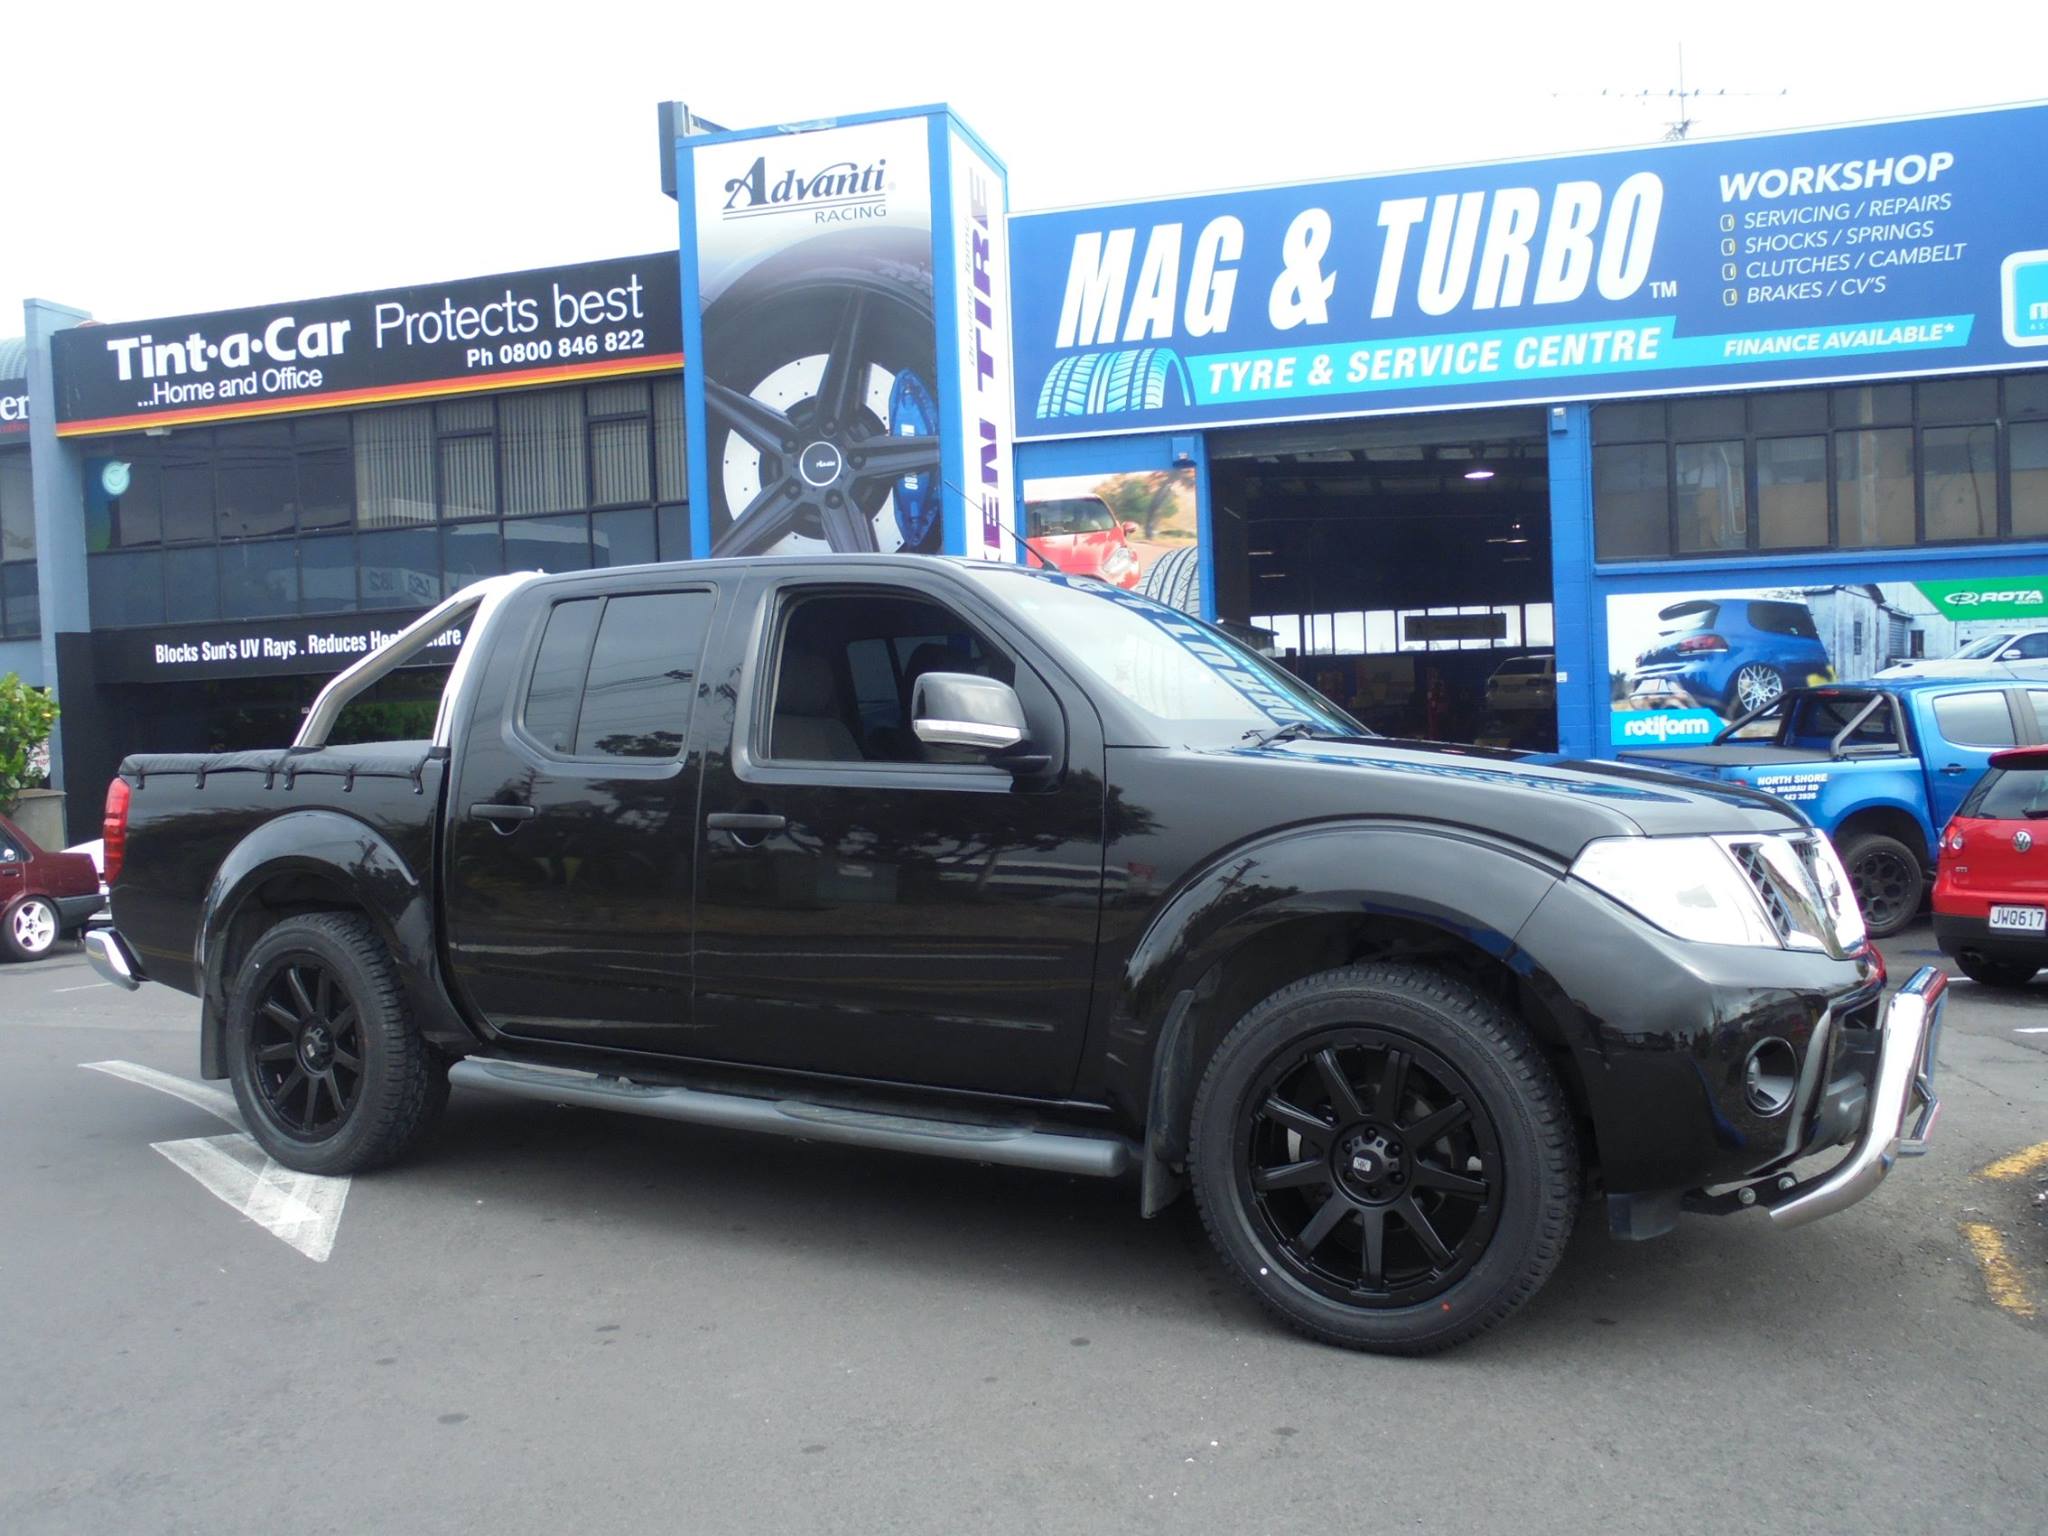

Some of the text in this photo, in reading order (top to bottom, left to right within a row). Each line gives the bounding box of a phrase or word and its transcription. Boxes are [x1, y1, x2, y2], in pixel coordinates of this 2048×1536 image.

[723, 156, 886, 210] Advanti
[1719, 151, 1955, 203] WORKSHOP
[815, 203, 886, 224] RACING
[1743, 202, 1851, 230] SERVICING
[1868, 193, 1952, 217] REPAIRS
[1744, 230, 1828, 254] SHOCKS
[1845, 221, 1935, 245] SPRINGS
[1055, 215, 1245, 349] MAG
[1268, 207, 1337, 331] &
[1370, 171, 1664, 319] TURBO
[1745, 253, 1851, 280] CLUTCHES
[1868, 243, 1968, 268] CAMBELT
[1746, 281, 1823, 304] BRAKES
[375, 274, 644, 349] Protects best
[467, 329, 645, 368] Ph 0800 846 822
[1208, 327, 1662, 395] TYRE & SERVICE CENTRE
[1723, 333, 1820, 358] FINANCE
[219, 371, 257, 397] and
[262, 366, 323, 393] Office
[155, 642, 198, 664] Blocks
[201, 640, 237, 661] Sun's
[240, 638, 259, 658] UV
[263, 637, 297, 660] Rays
[308, 633, 366, 654] Reduces
[1624, 714, 1709, 742] rotiform
[1757, 773, 1828, 786] NORTH SHORE
[1991, 908, 2045, 928] JWQ617
